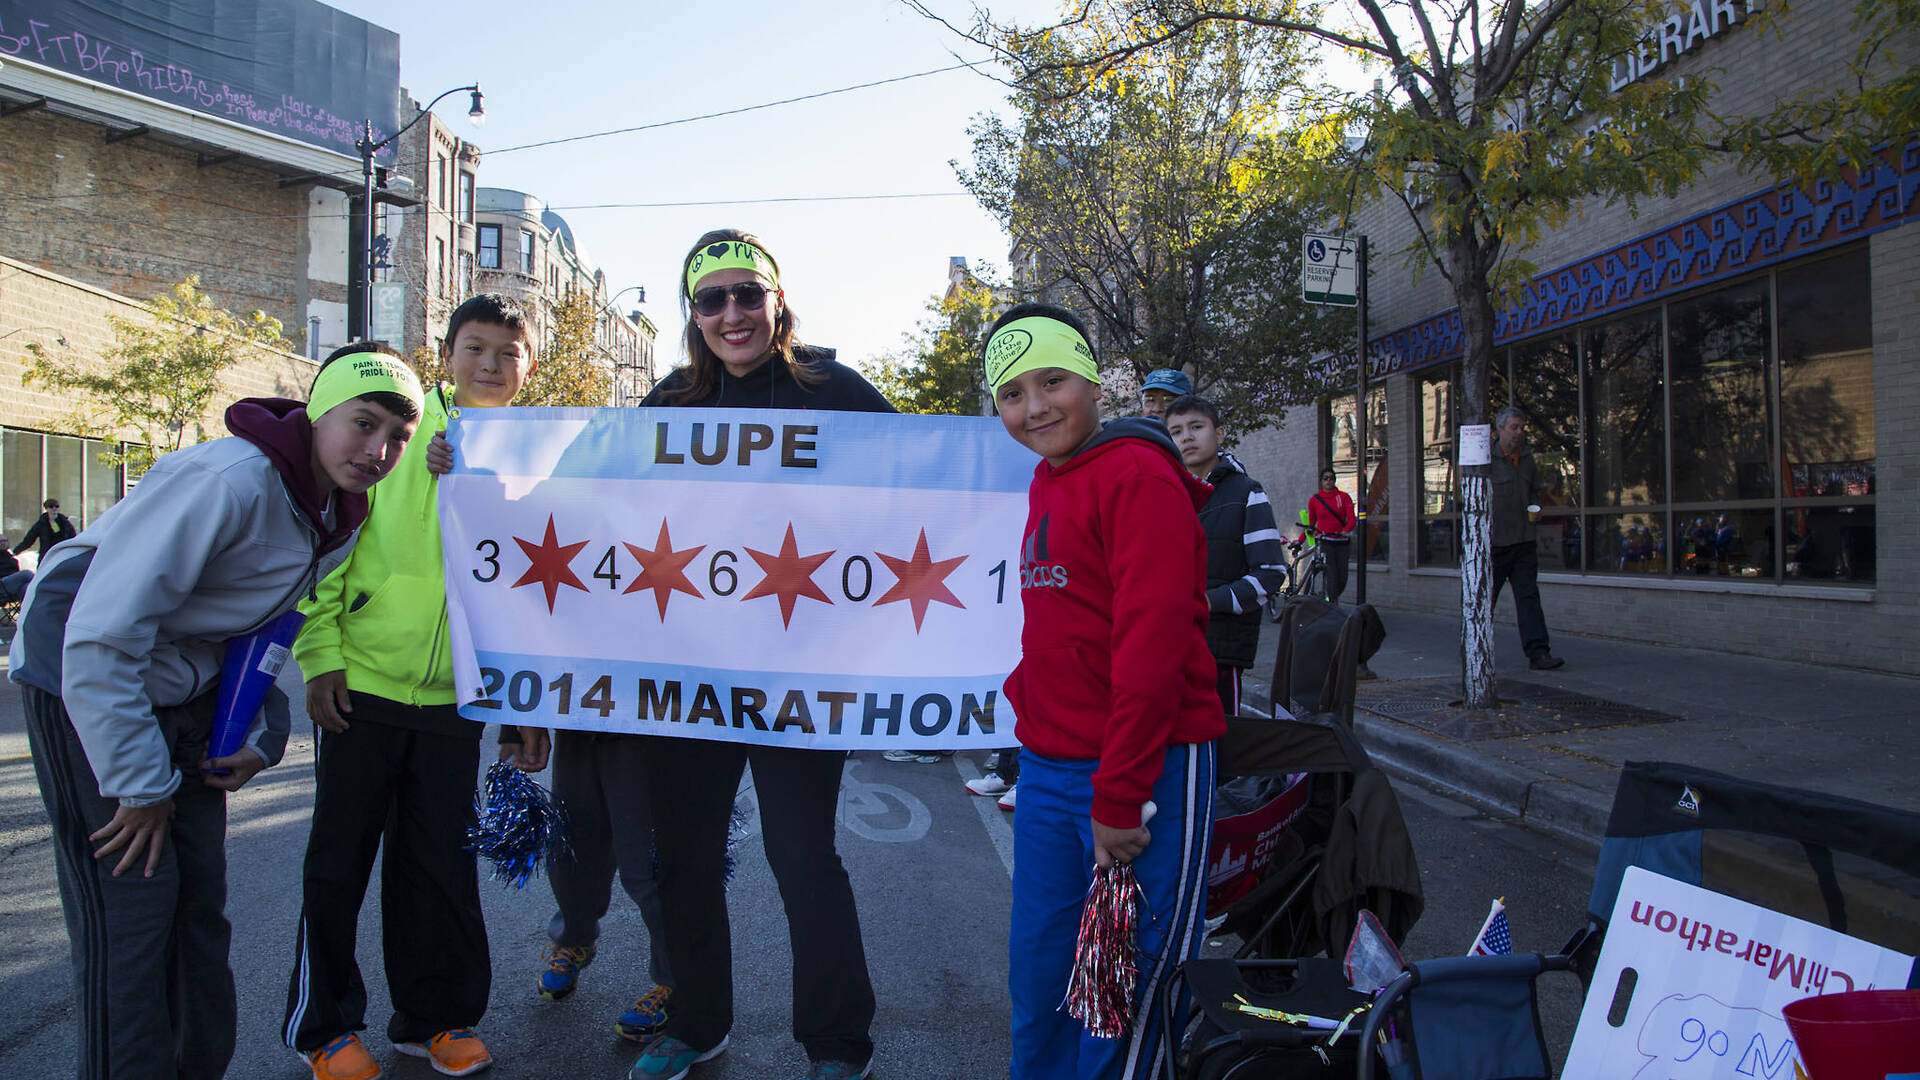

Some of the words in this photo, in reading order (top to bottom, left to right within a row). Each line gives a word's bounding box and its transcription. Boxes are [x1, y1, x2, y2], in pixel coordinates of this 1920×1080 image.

[1610, 0, 1760, 92] LIBRAR
[1307, 274, 1333, 283] PARKIN
[353, 361, 373, 370] PAIN
[360, 369, 384, 379] PRIDE
[386, 370, 393, 378] IS
[655, 421, 819, 469] LUPE
[471, 539, 501, 584] 3
[593, 545, 622, 590] 4
[708, 550, 739, 597] 6
[841, 555, 873, 602] 0
[988, 559, 1007, 604] 1
[1020, 561, 1068, 589] didas
[468, 667, 616, 718] 2014
[637, 678, 998, 737] MARATHON
[1630, 901, 1876, 997] ChiMarathon
